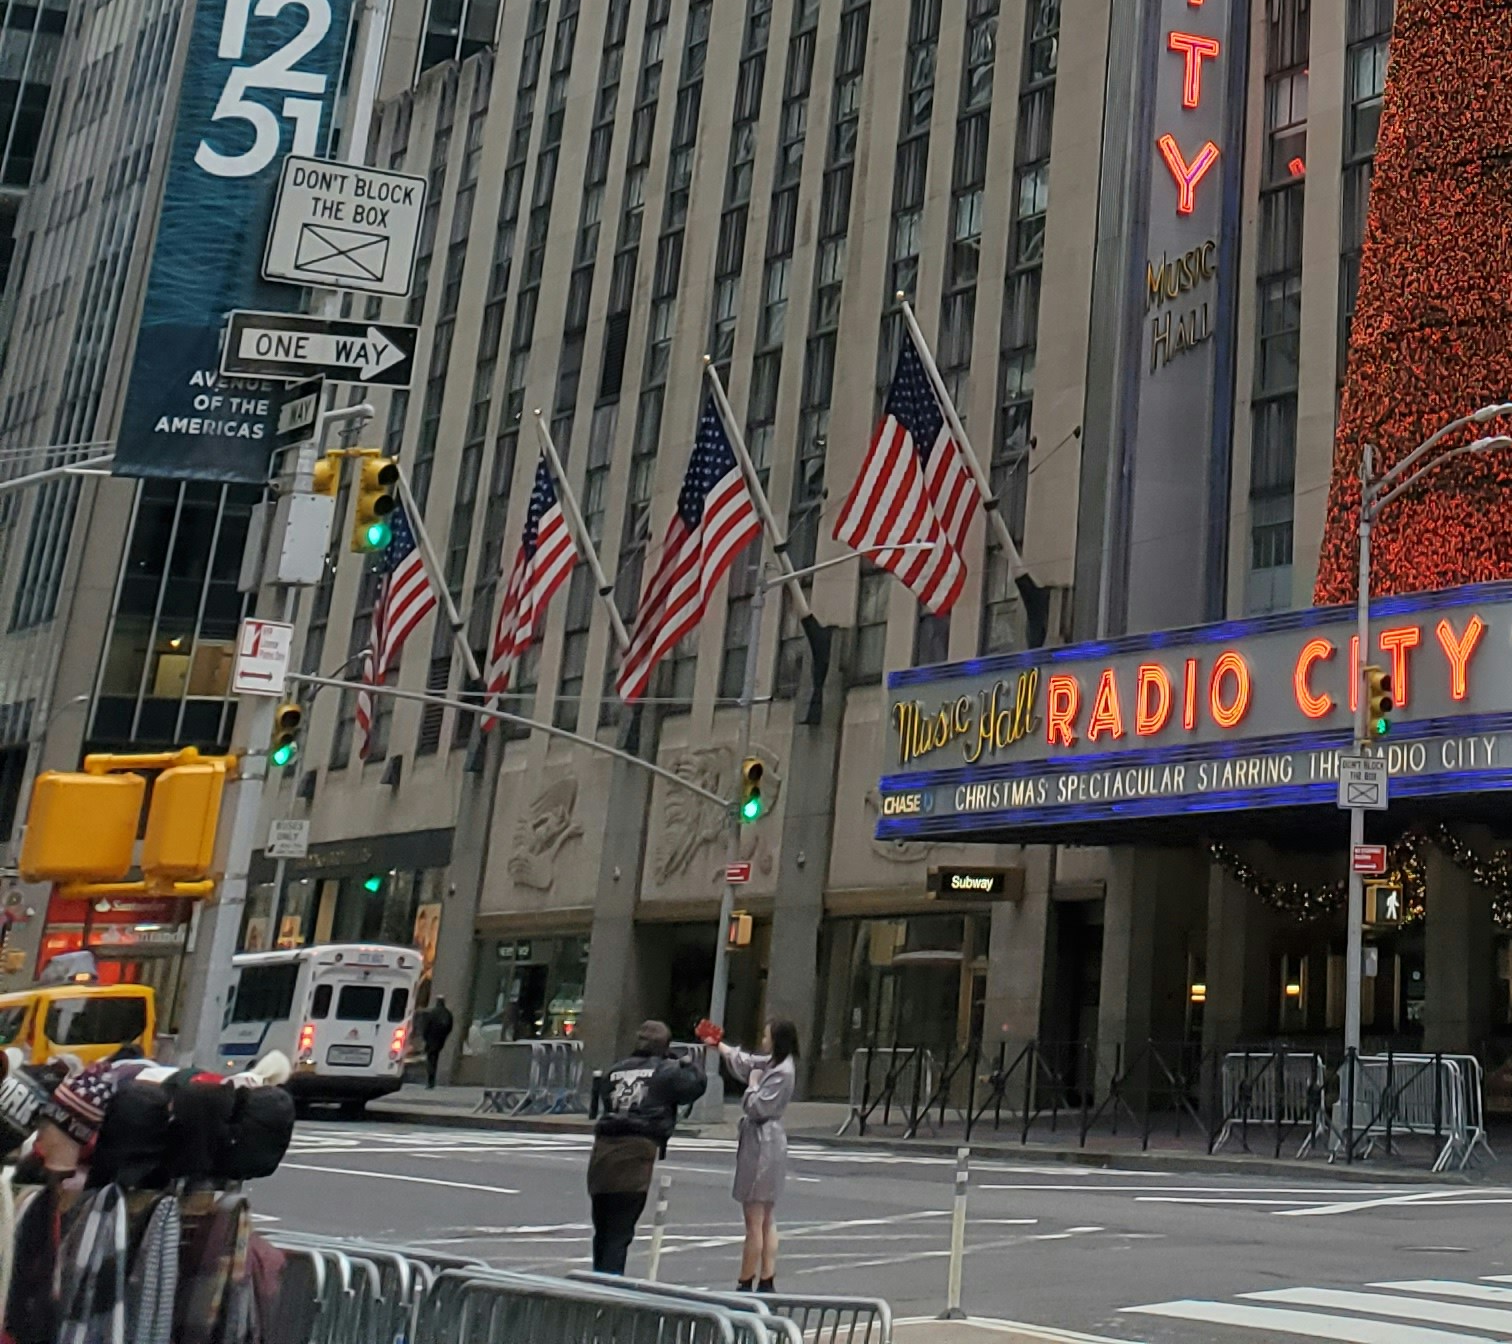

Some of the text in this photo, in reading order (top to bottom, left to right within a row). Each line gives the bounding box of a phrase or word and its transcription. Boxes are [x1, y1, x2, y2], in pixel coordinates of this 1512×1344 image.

[293, 167, 415, 206] DON'T BLOCK
[311, 197, 390, 228] THE BOX
[255, 333, 389, 366] ONE WAY
[189, 370, 273, 392] AVENUE
[193, 394, 270, 416] OF THE
[154, 415, 265, 440] AMERICAS
[1046, 614, 1487, 748] RADIO CITY
[891, 667, 1042, 765] Music Hall
[955, 777, 1046, 811] CHRISTMAS
[1057, 765, 1185, 802] SPECTACULAR
[1197, 754, 1293, 789] STARRING
[1441, 735, 1496, 768] CITY
[884, 793, 922, 815] CHASE
[951, 875, 994, 892] Subway
